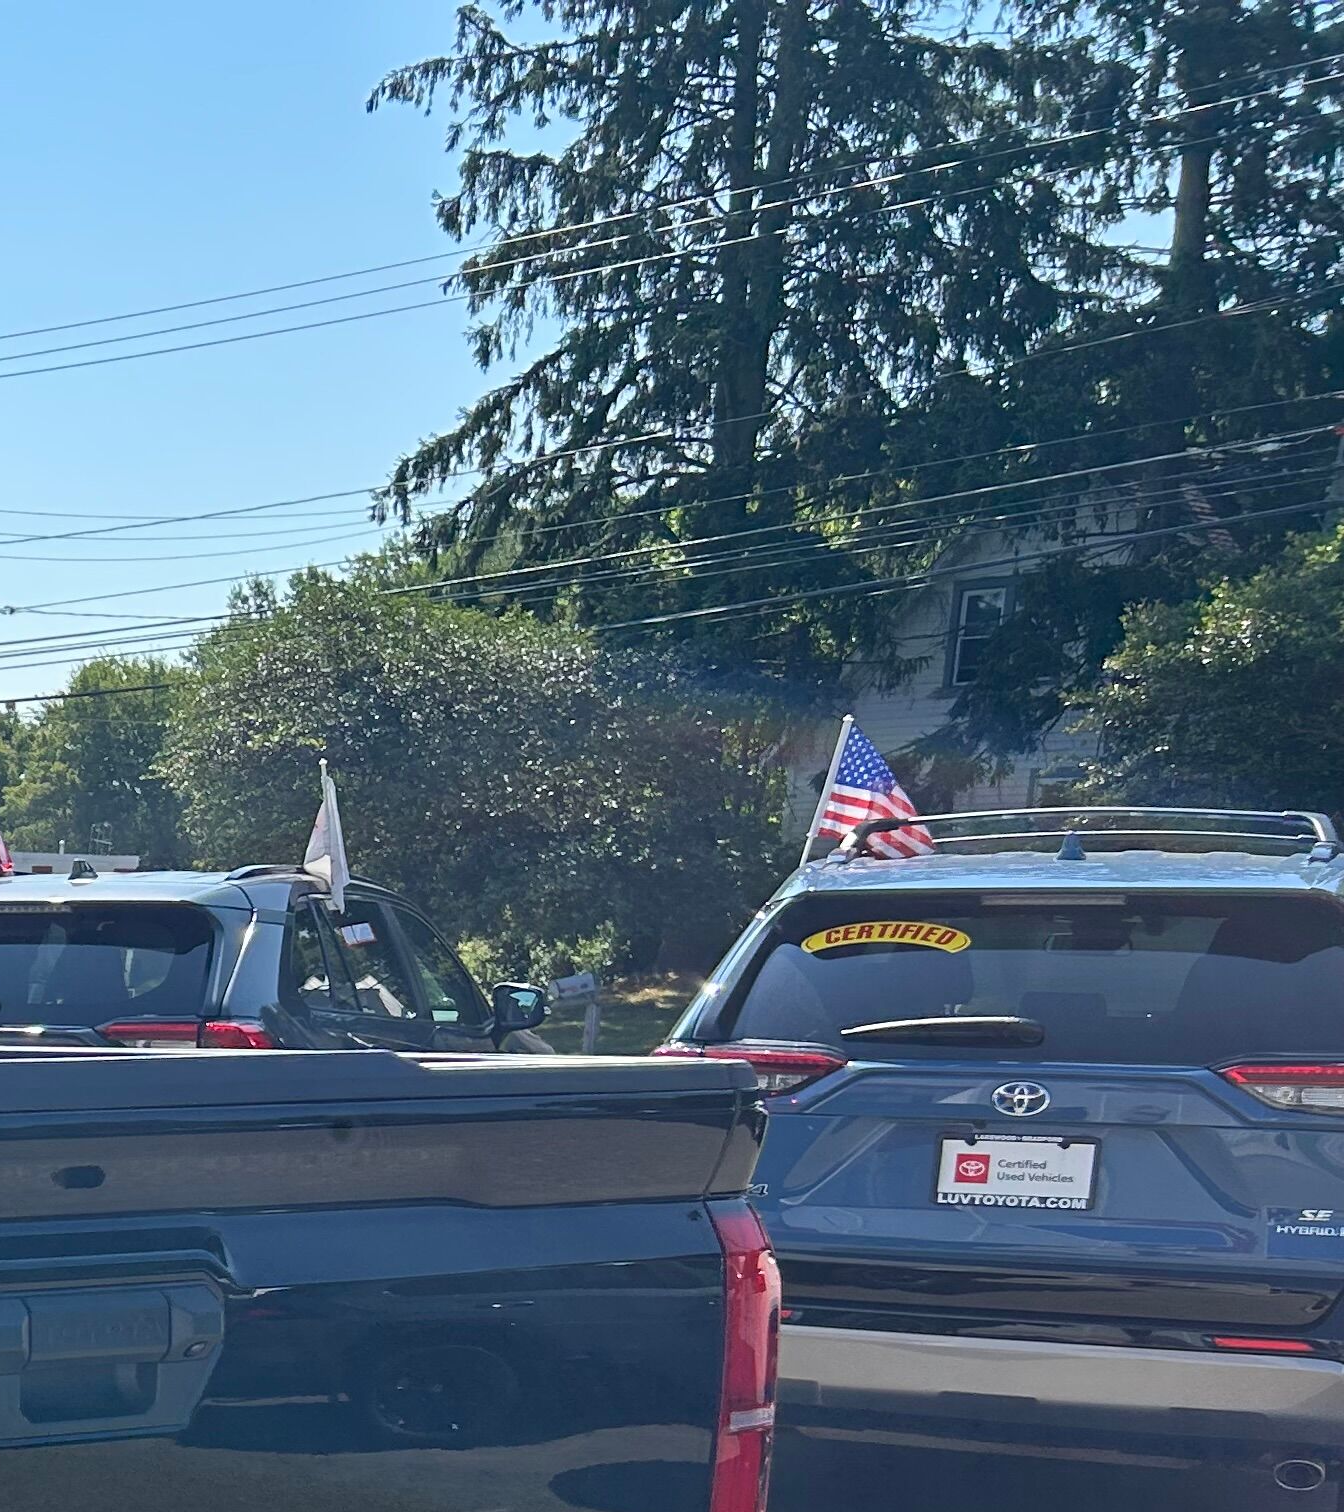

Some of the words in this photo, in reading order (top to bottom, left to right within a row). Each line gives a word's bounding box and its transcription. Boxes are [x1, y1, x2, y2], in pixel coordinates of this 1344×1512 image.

[825, 922, 958, 946] CERTIFIED
[997, 1159, 1047, 1170] Certified
[996, 1172, 1025, 1181] Used
[1028, 1173, 1074, 1183] Vehicles
[937, 1193, 1087, 1209] LUVTOYOTA.COM
[1298, 1209, 1334, 1221] SE
[1276, 1225, 1336, 1236] HYBRID
